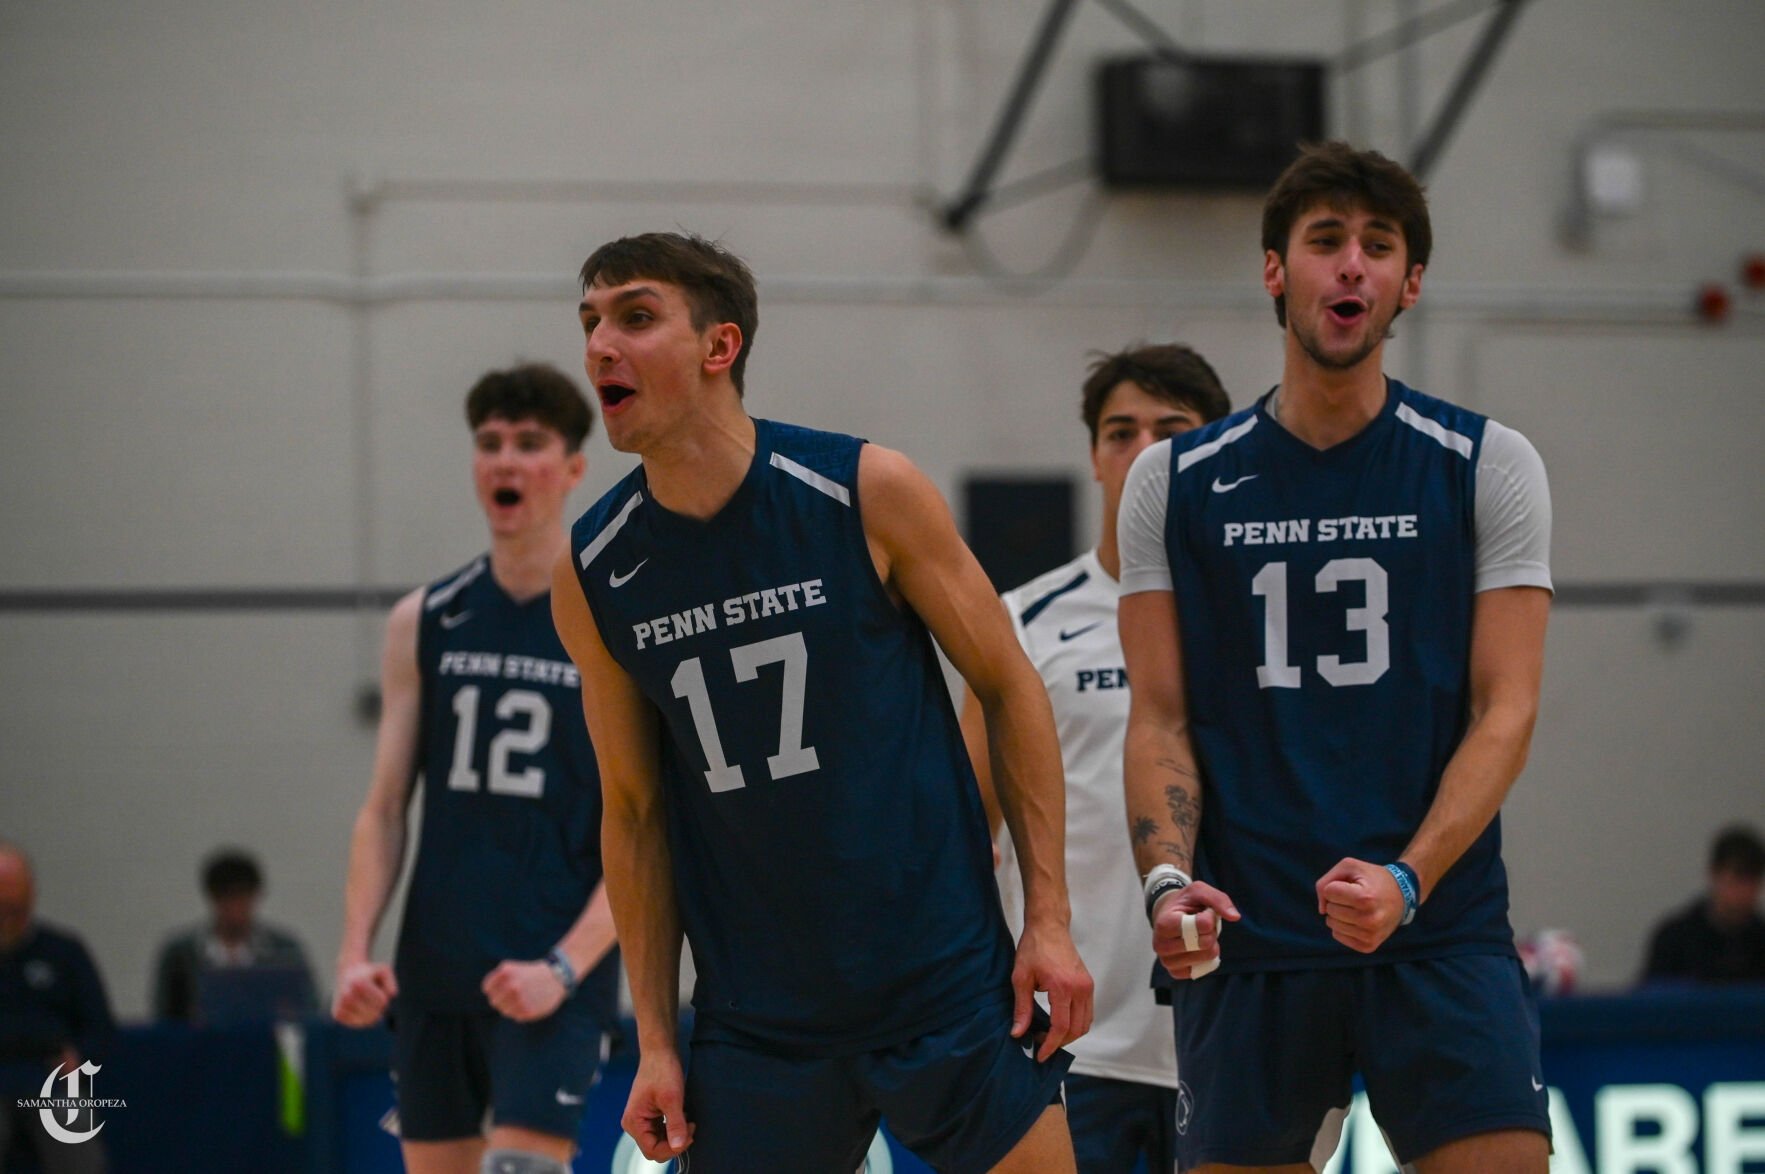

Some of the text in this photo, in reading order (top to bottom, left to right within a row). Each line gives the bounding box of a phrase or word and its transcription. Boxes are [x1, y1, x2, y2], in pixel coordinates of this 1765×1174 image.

[1223, 514, 1418, 547] PENN STATE
[633, 578, 827, 650] PENN STATE
[1251, 556, 1391, 688] 13
[439, 651, 581, 688] PENN STATE
[670, 631, 821, 793] 17
[448, 684, 553, 799] 12
